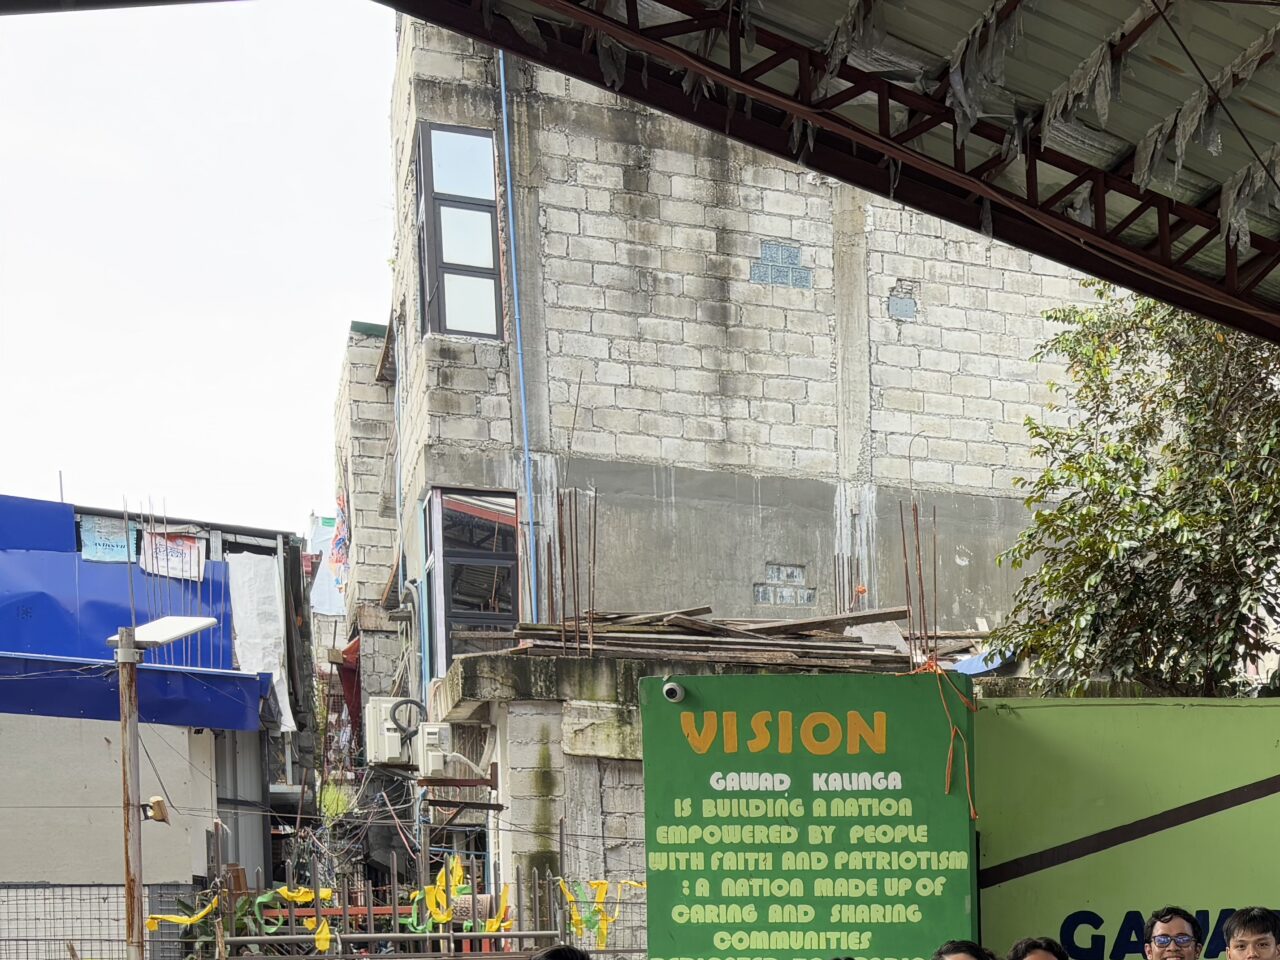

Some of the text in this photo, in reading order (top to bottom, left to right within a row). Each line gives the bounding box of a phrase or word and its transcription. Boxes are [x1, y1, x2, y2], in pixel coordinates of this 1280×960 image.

[680, 711, 887, 755] VISION
[709, 771, 902, 792] GAWAD KALINGA
[674, 798, 912, 818] IS BUILDING A NATION
[656, 825, 928, 845] EMPOWERED BY PEOPLE
[649, 851, 968, 871] WITH FAITH AND PATRIOTISM
[696, 878, 710, 896] A
[721, 878, 803, 897] NATION
[814, 878, 878, 897] MADE
[884, 878, 911, 896] UP
[916, 876, 946, 896] OF
[671, 904, 923, 923] CARING AND SHARING
[713, 931, 872, 950] COMMUNITIES
